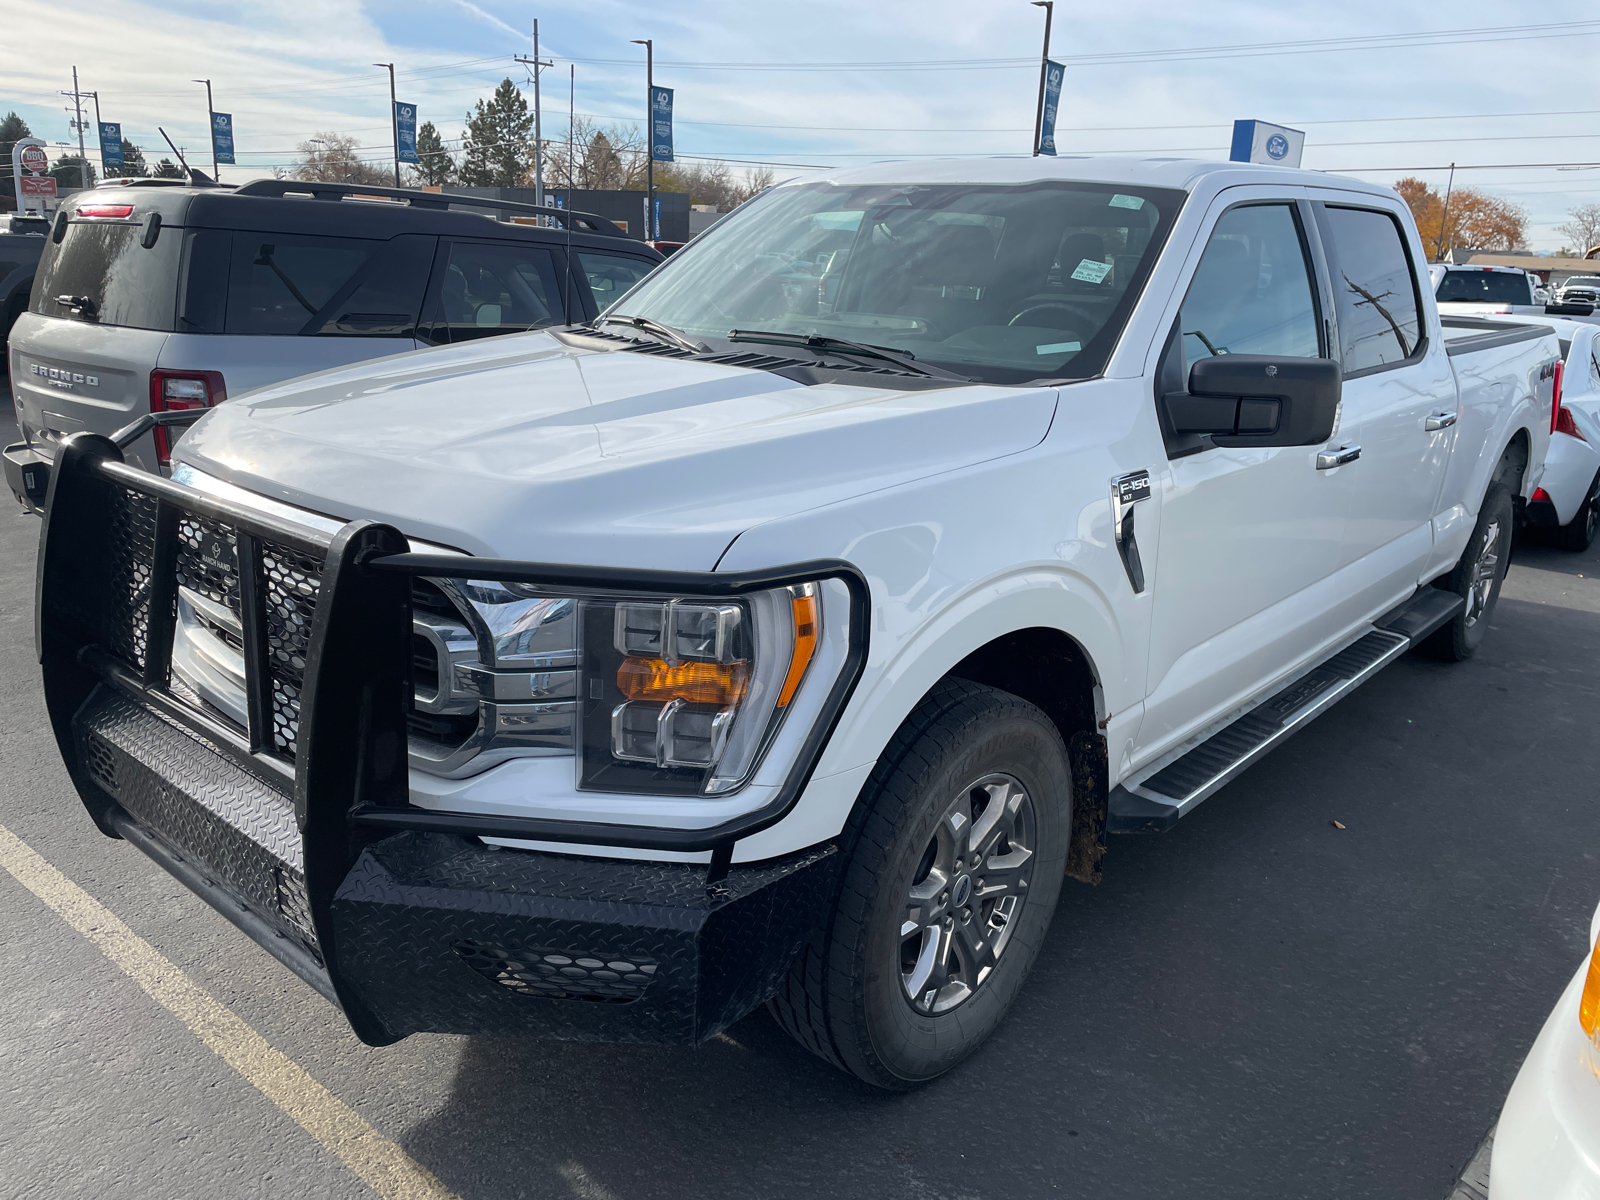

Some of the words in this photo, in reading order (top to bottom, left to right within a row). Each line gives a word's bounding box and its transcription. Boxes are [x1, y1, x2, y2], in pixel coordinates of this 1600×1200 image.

[657, 91, 669, 103] 40
[401, 107, 411, 116] 40
[216, 116, 227, 124] 40
[1269, 136, 1286, 155] Ford
[26, 150, 43, 161] BBQ
[30, 363, 99, 387] BRONCO
[1121, 478, 1149, 493] F-150
[203, 555, 216, 567] RANCH
[217, 561, 230, 571] HAND
